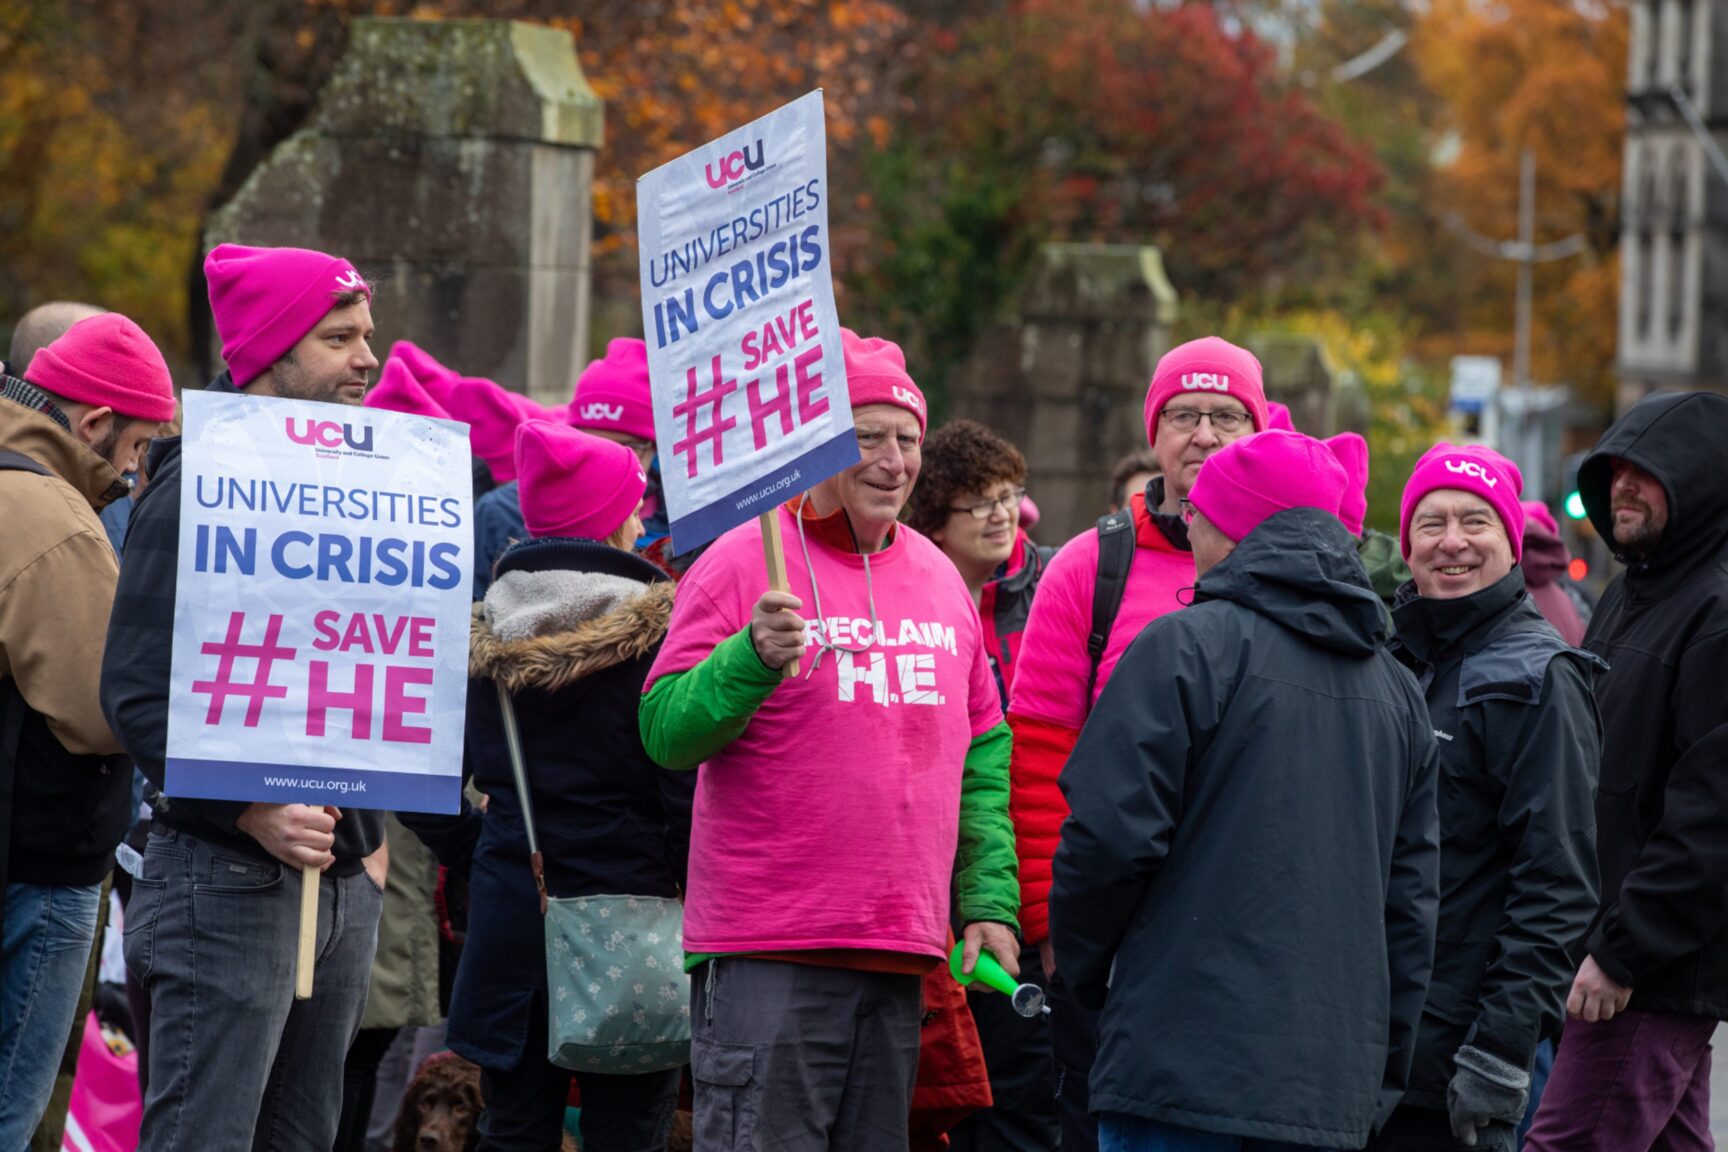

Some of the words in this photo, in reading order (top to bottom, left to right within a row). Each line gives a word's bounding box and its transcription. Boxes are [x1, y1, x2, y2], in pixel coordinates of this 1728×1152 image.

[651, 178, 820, 288] UNIVERSITIES
[654, 288, 698, 349] IN
[703, 225, 822, 320] CRISIS
[740, 299, 819, 370] SAVE
[196, 475, 461, 528] UNIVERSITIES
[735, 469, 801, 510] www.ucu.org.uk
[195, 524, 257, 576] IN
[271, 530, 461, 590] CRISIS
[312, 610, 436, 657] SAVE
[803, 616, 957, 656] RECLAIM
[835, 651, 945, 707] H.E.
[264, 776, 367, 793] www.ucu.org.uk
